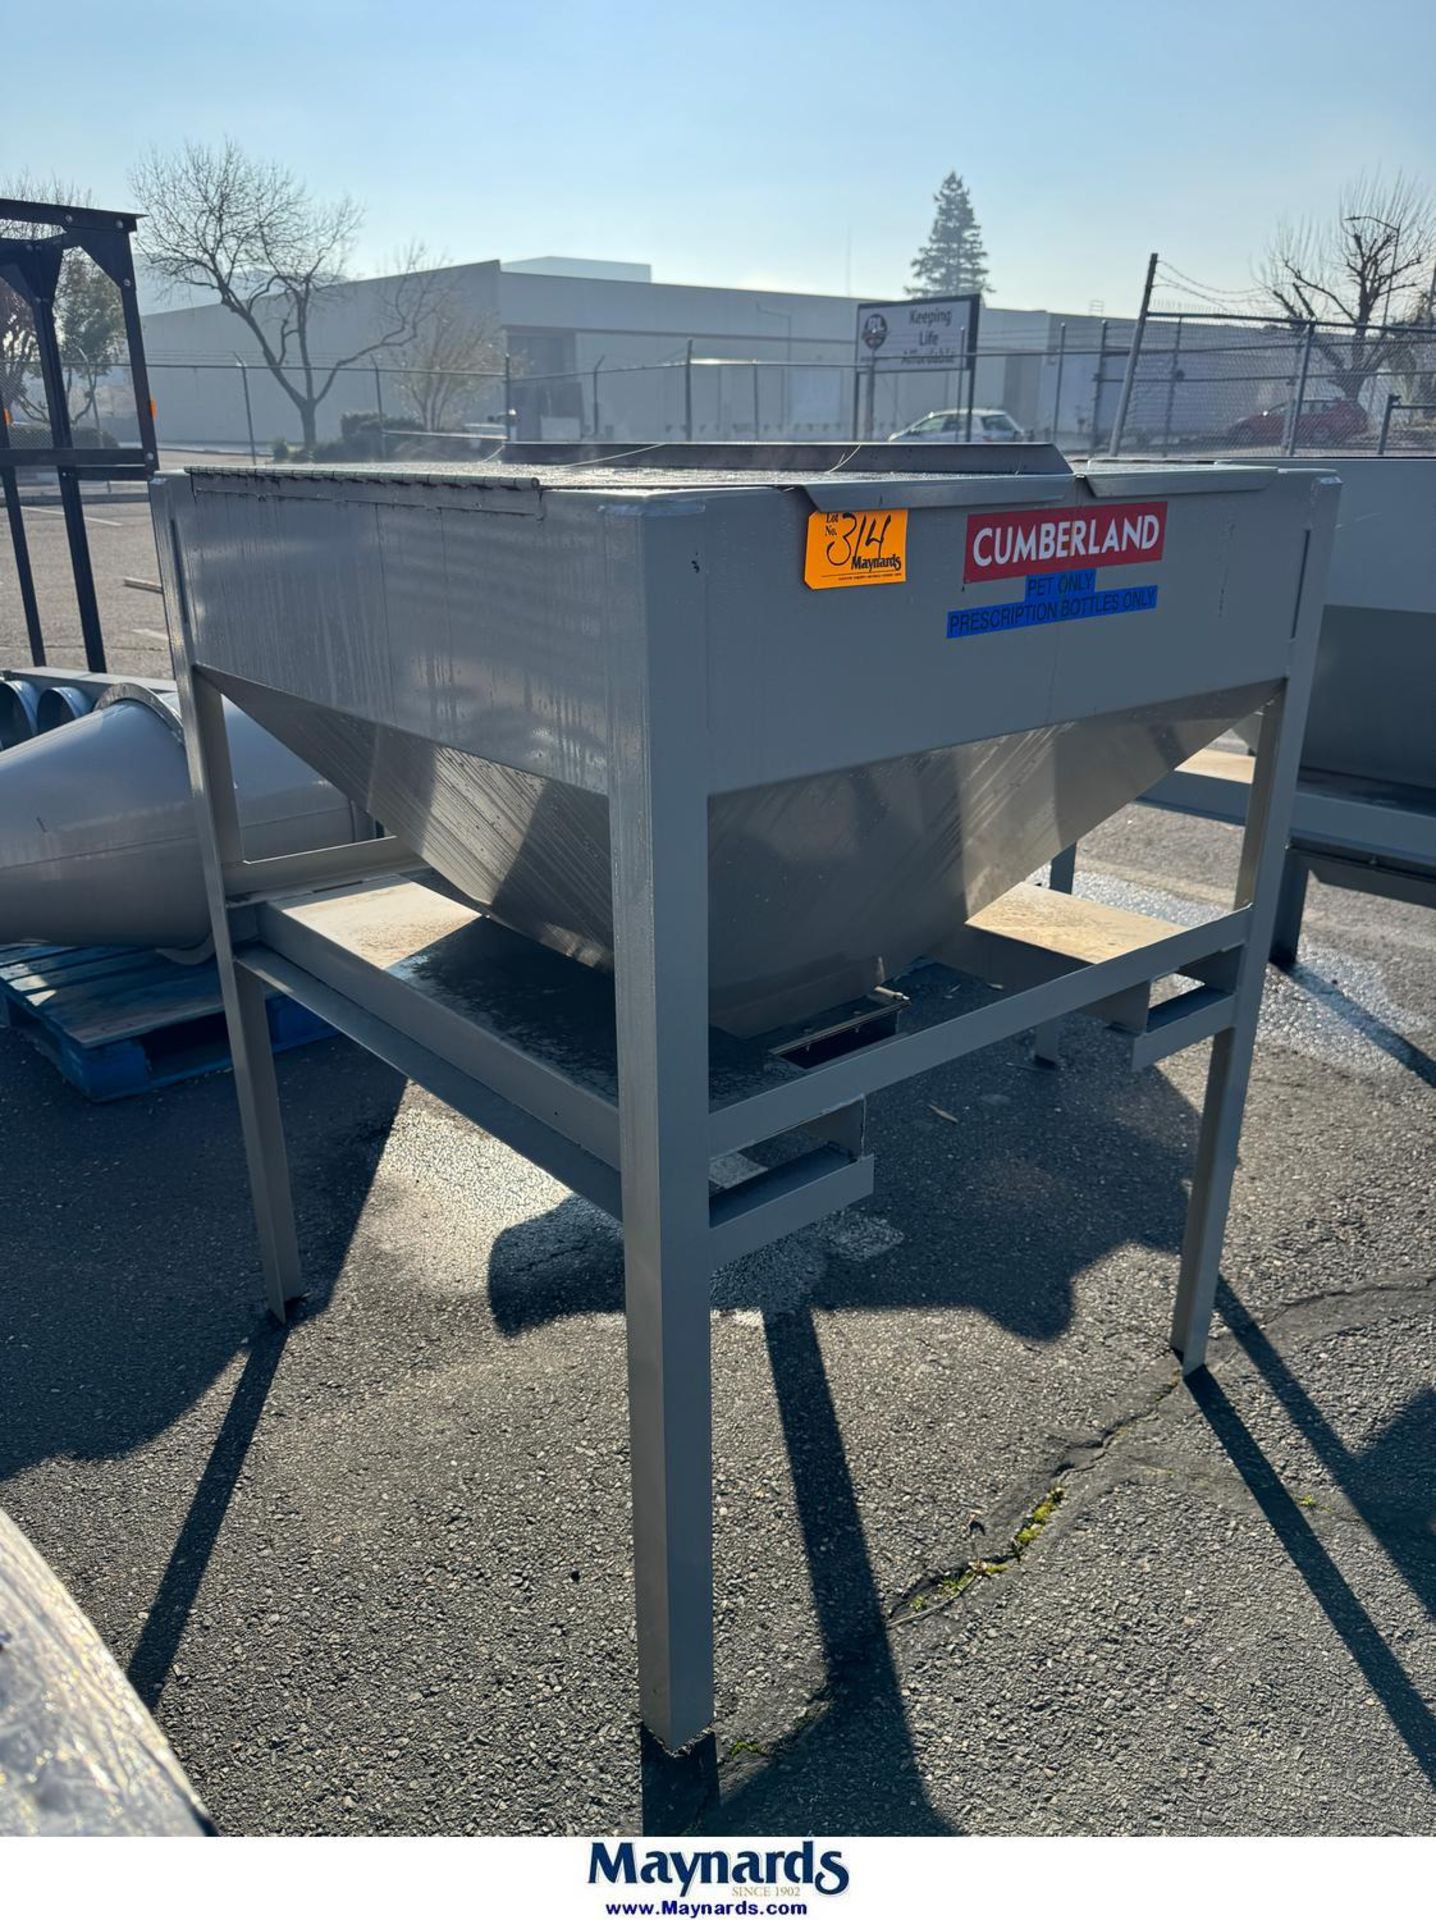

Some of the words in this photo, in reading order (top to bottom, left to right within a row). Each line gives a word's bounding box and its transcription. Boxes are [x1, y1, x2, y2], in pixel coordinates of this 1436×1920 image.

[909, 308, 952, 327] Keeping
[918, 331, 939, 346] Life
[826, 512, 892, 566] 314
[972, 513, 1160, 568] CUMBERLAND
[851, 552, 902, 573] Maynards
[1028, 577, 1055, 596] PET
[1057, 573, 1095, 594] ONLY
[948, 600, 1058, 634] PRESCRIPTION
[1061, 593, 1120, 619] BOTTLES
[1122, 587, 1157, 611] ONLY
